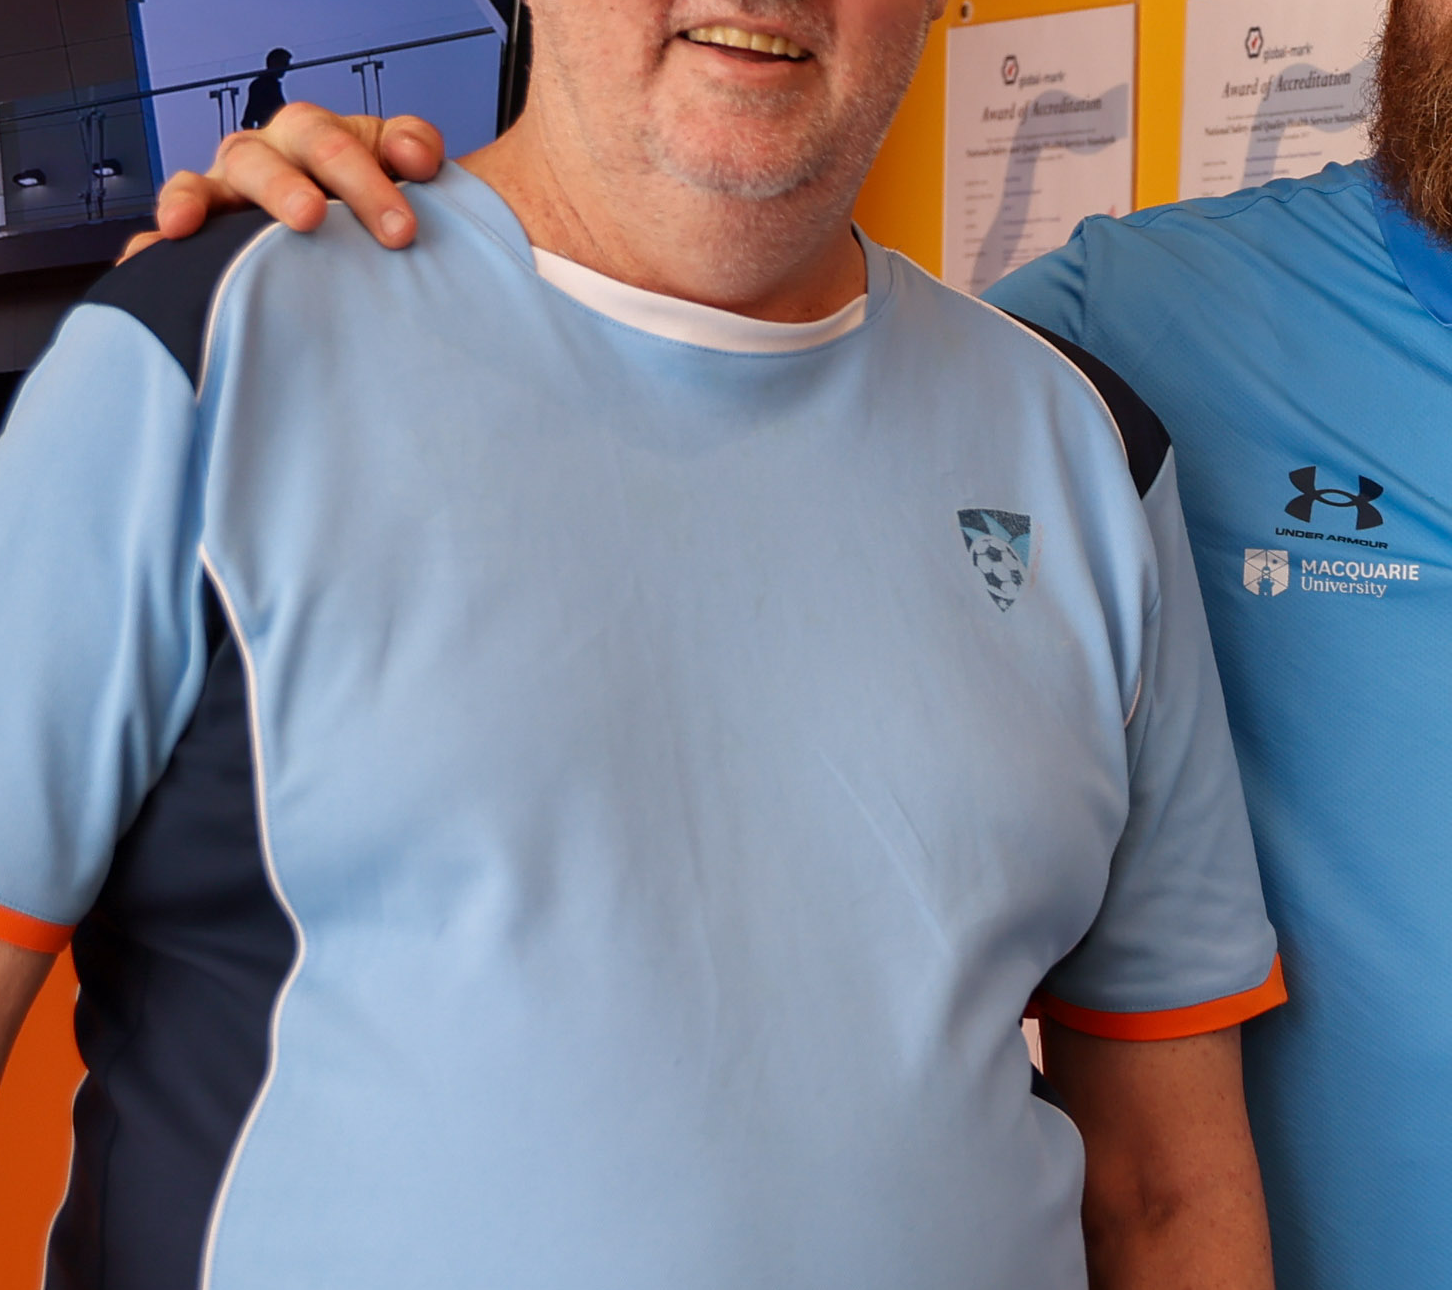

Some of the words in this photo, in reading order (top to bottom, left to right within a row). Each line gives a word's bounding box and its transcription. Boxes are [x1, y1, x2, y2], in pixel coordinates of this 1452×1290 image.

[1221, 76, 1260, 99] Award
[1261, 74, 1274, 102] of
[1275, 68, 1352, 94] Accreditation
[980, 100, 1016, 123] Award
[1017, 100, 1033, 127] of
[1033, 94, 1103, 118] Accreditation
[1275, 527, 1325, 540] UNDER
[1326, 534, 1389, 550] ARMOUR
[1301, 559, 1421, 582] MACQUARIE
[1300, 577, 1388, 598] University
